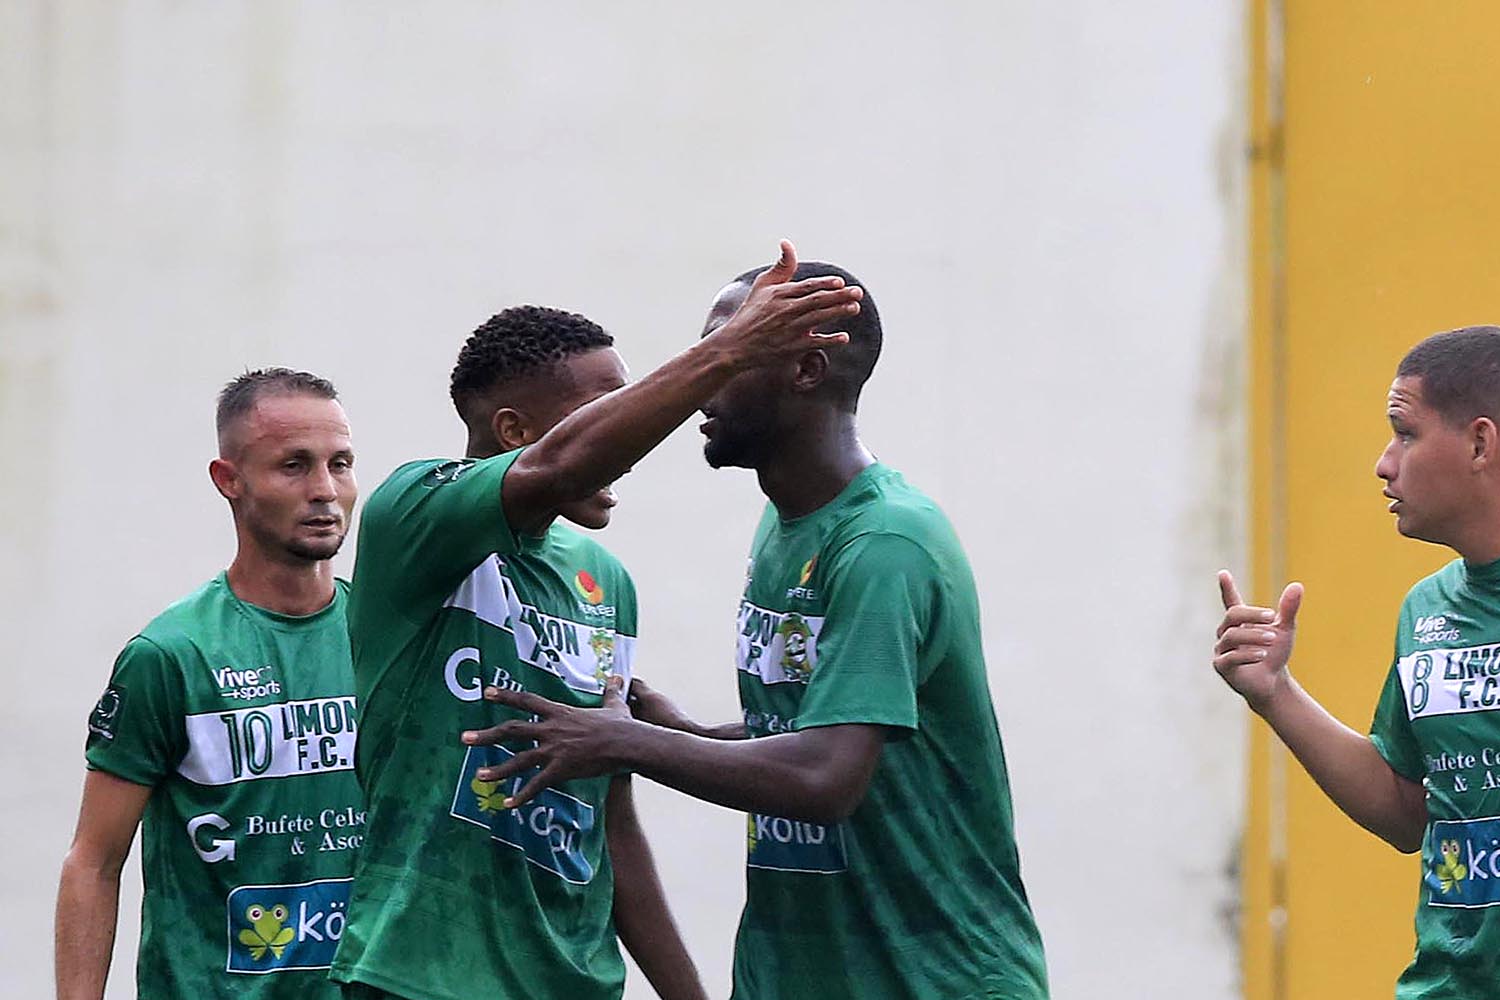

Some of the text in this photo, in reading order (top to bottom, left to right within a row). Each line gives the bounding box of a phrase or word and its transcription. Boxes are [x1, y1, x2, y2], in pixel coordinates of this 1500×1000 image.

[212, 666, 259, 689] Vive
[1410, 653, 1434, 714] 8
[220, 711, 273, 779] 10
[297, 736, 348, 771] F.C.
[246, 815, 314, 836] Bufete
[290, 836, 306, 855] &
